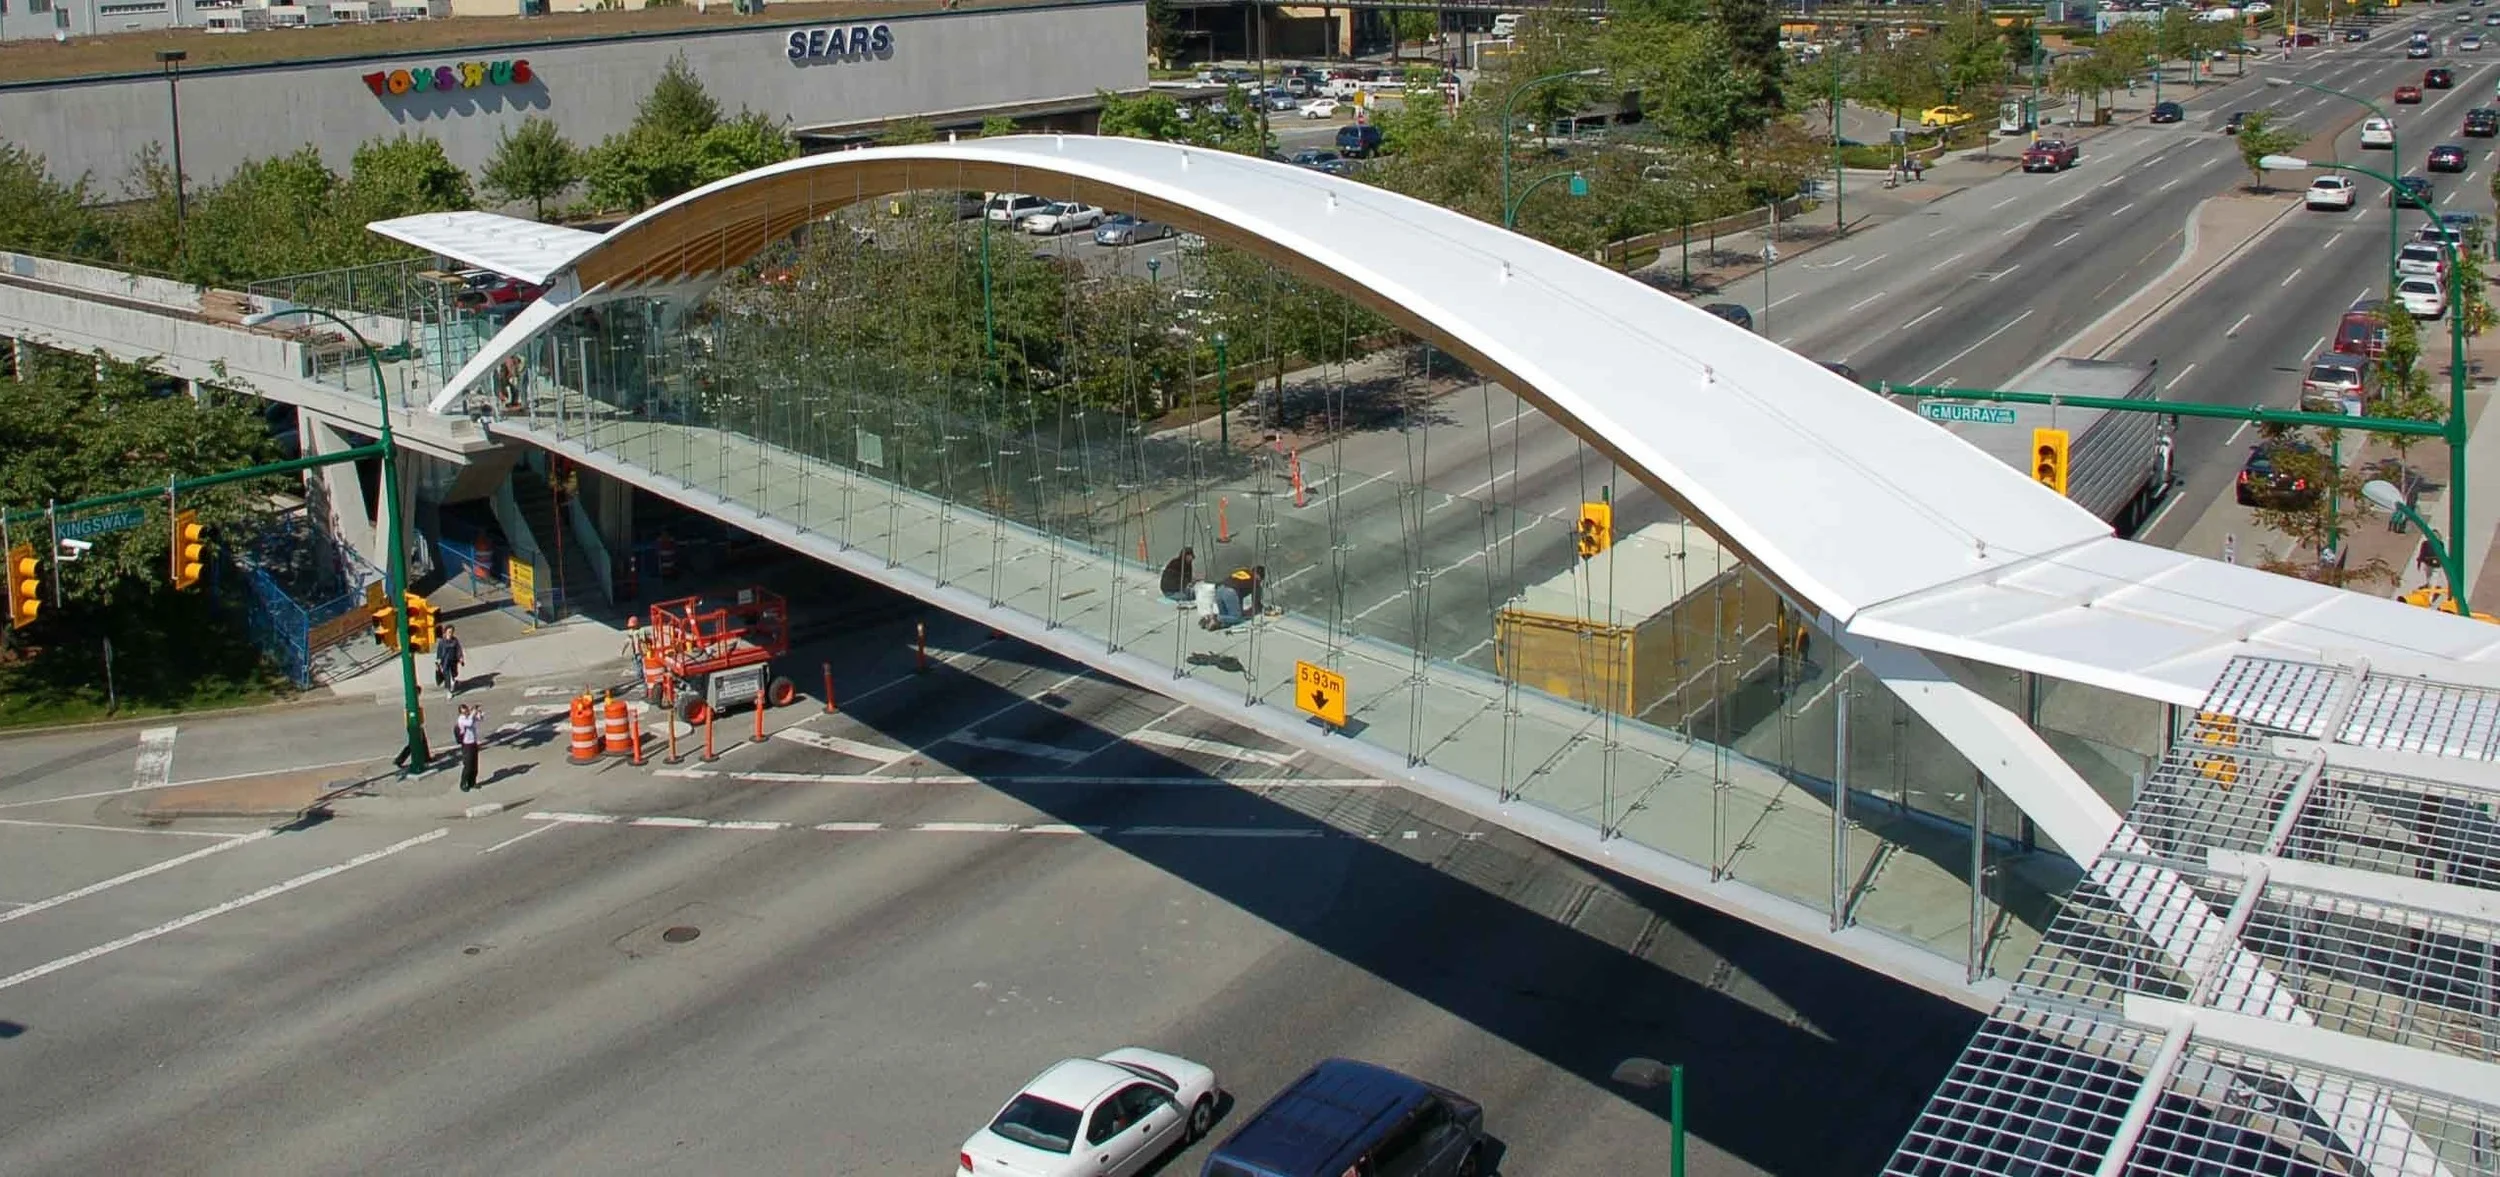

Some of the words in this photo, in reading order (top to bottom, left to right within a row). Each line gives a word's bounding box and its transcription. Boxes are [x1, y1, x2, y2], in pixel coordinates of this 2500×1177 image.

[787, 25, 890, 58] SEARS
[362, 66, 455, 96] TOYS
[490, 60, 532, 85] US
[1920, 405, 1997, 421] McMURRAY
[57, 513, 128, 537] KINGSWAY
[1301, 667, 1340, 692] 5.93m
